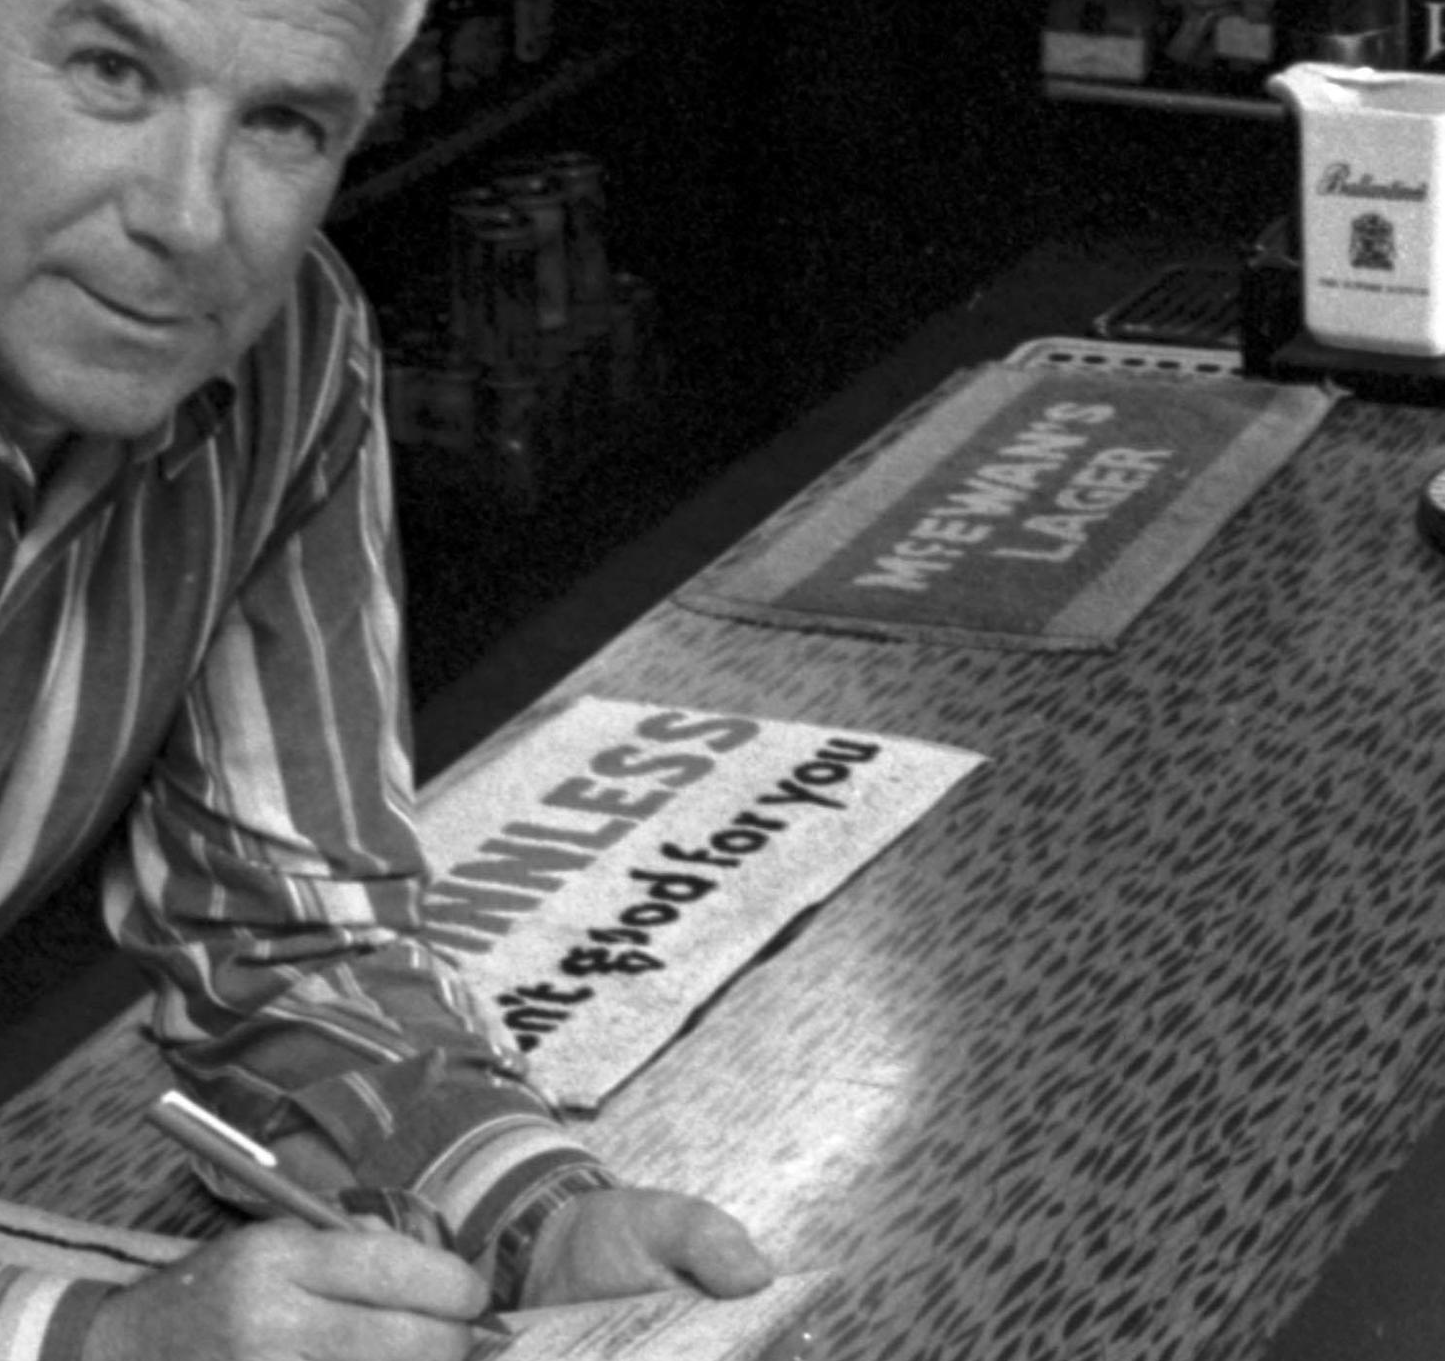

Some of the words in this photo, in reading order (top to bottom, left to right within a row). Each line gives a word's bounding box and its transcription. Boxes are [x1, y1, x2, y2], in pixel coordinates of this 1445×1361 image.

[988, 447, 1174, 563] LAGER
[422, 711, 762, 954] INNLESS
[660, 811, 788, 869] for
[758, 738, 882, 812] you
